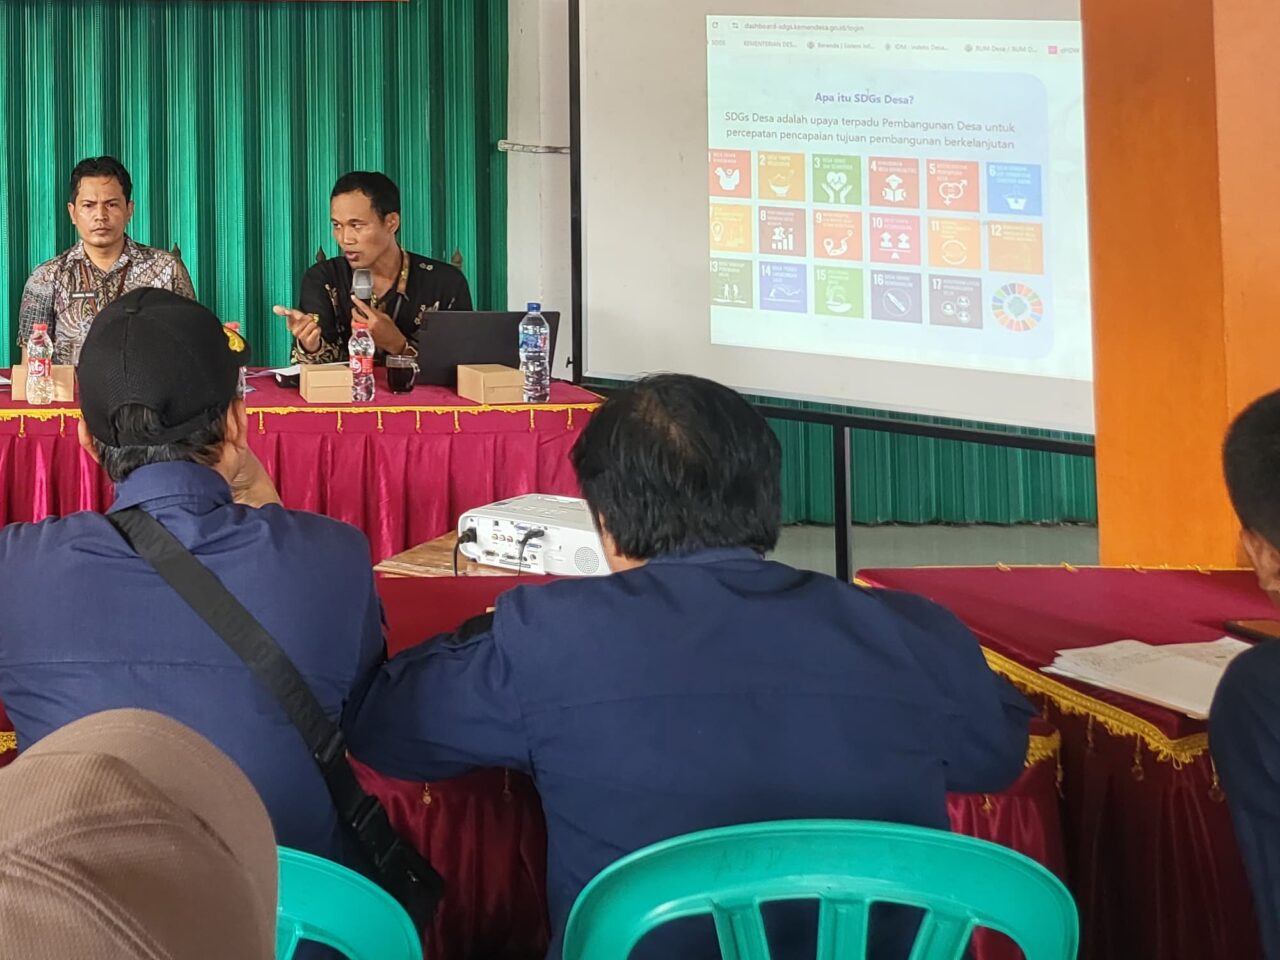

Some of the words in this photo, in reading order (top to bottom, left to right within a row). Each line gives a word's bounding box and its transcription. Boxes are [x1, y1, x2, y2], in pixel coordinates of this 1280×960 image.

[815, 92, 834, 105] Apa
[837, 93, 851, 103] itu
[854, 93, 881, 104] SDGs
[884, 95, 914, 105] Desa?
[725, 111, 750, 122] SDGs
[752, 112, 775, 123] Desa
[777, 114, 808, 124] adalah
[810, 117, 839, 128] upaya
[842, 117, 879, 128] terpadu
[882, 118, 954, 132] Pembangunan
[957, 121, 982, 132] Desa
[985, 122, 1016, 133] untuk
[726, 128, 778, 140] percepatan
[780, 130, 834, 142] pencapaian
[836, 133, 867, 144] tujuan
[869, 134, 942, 148] pembangunan
[944, 137, 1015, 150] berkelanjutan
[759, 154, 766, 166] 2
[814, 157, 821, 169] 3
[870, 160, 877, 172] 4
[929, 163, 936, 175] 5
[989, 165, 996, 177] 6
[760, 209, 766, 221] 8
[815, 212, 822, 223] 9
[871, 216, 883, 228] 10
[931, 220, 940, 232] 11
[991, 224, 1002, 236] 12
[761, 264, 771, 277] 14
[816, 269, 826, 281] 15
[873, 273, 884, 286] 16
[932, 278, 942, 290] 17
